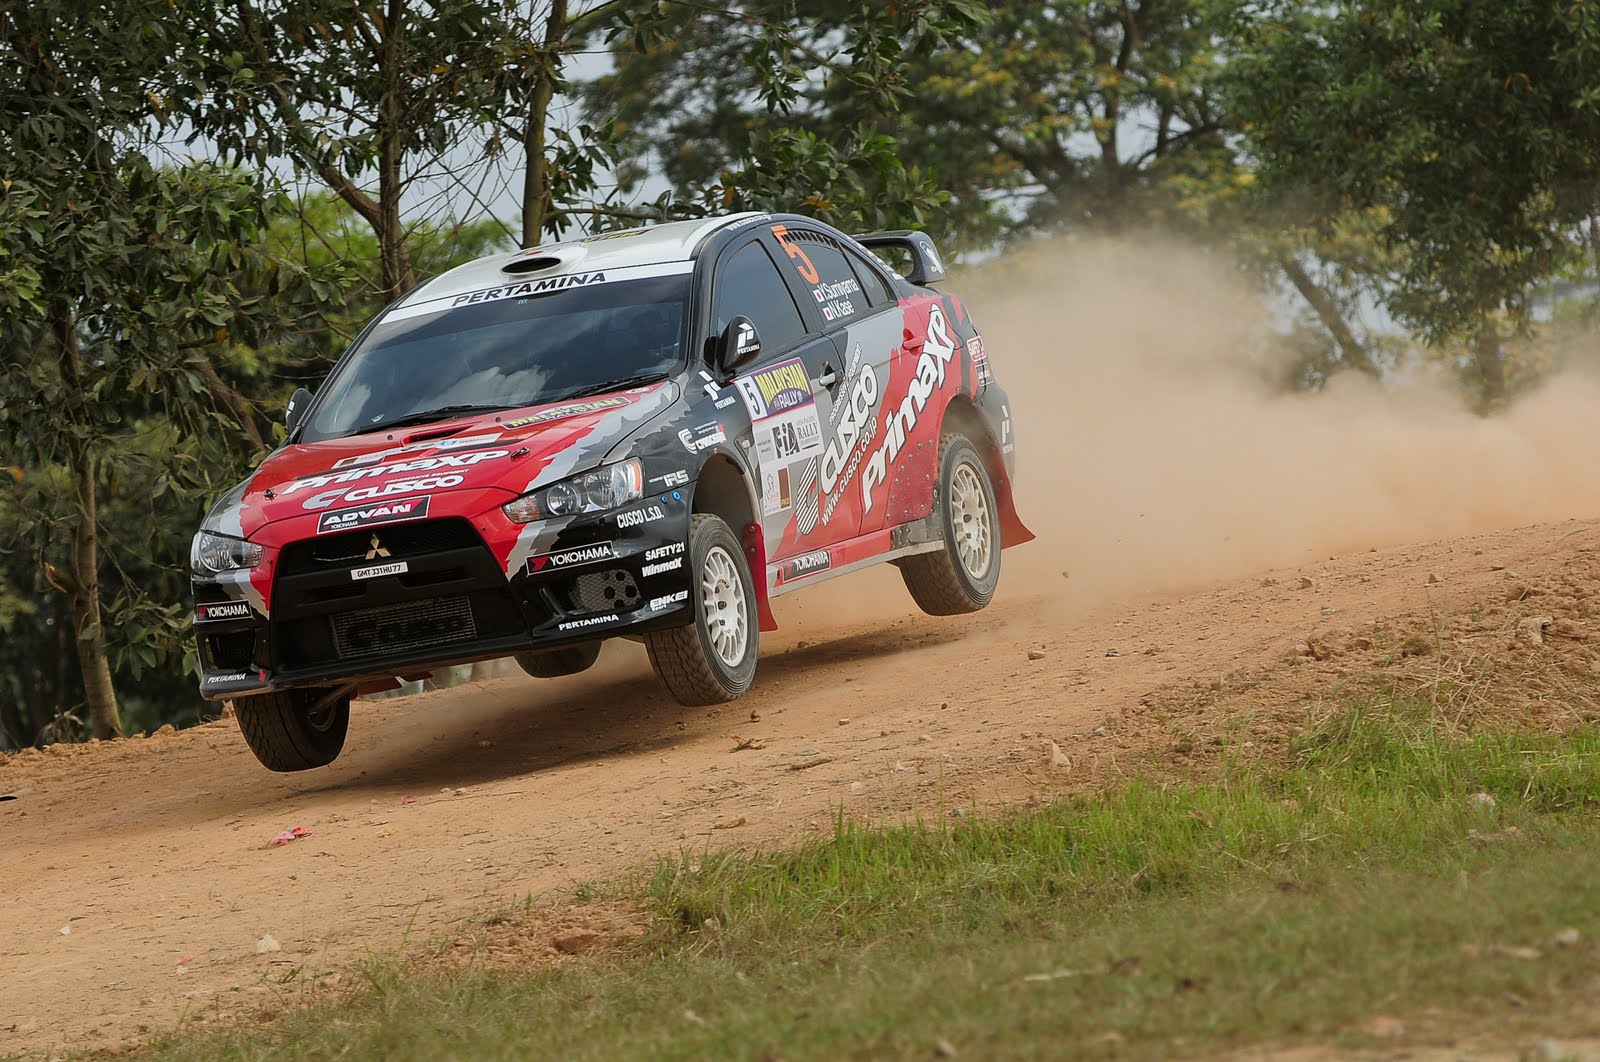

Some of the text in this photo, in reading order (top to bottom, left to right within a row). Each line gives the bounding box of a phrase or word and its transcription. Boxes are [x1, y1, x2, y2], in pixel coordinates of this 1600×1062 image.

[771, 225, 819, 284] 5
[451, 272, 606, 307] PERTAMINA
[755, 363, 811, 408] MALAYSIAN
[743, 382, 761, 415] 5
[778, 389, 798, 409] RALLY
[511, 398, 621, 427] MALAYSIAN
[797, 422, 820, 440] RALLY
[344, 475, 464, 501] CUSCO
[323, 504, 411, 525] ADVAN
[617, 505, 665, 529] CUSCO L.S.D.
[550, 545, 611, 567] YOKOHAMA
[357, 569, 371, 577] GMT
[207, 604, 248, 618] YOKOHAMA
[559, 614, 619, 631] PERTAMINA
